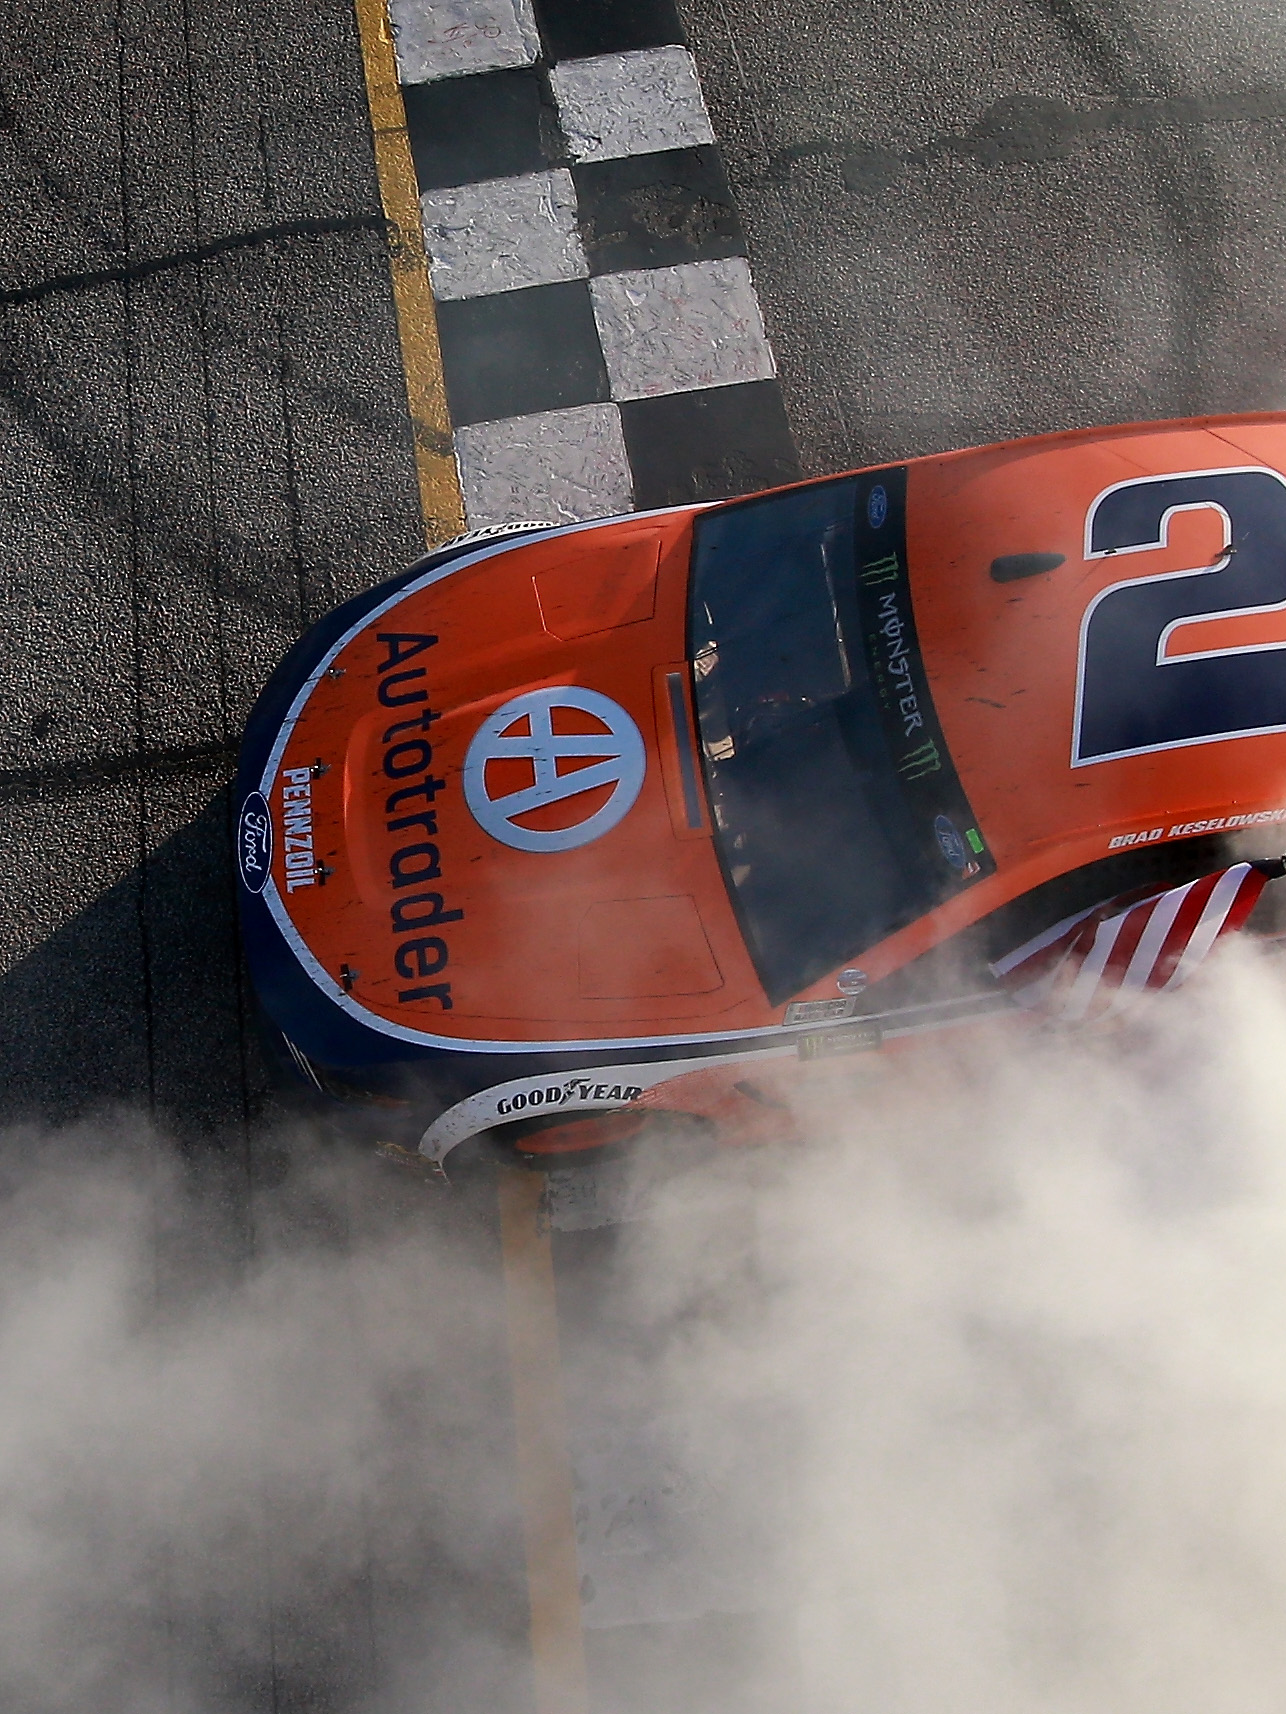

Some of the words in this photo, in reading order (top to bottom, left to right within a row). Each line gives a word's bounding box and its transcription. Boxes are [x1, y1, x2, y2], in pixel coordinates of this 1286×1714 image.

[878, 592, 923, 737] MONSTER
[244, 812, 268, 873] Ford
[282, 767, 315, 894] PENNZOIL
[375, 632, 467, 1010] Autotrader
[1108, 828, 1164, 849] BRAD
